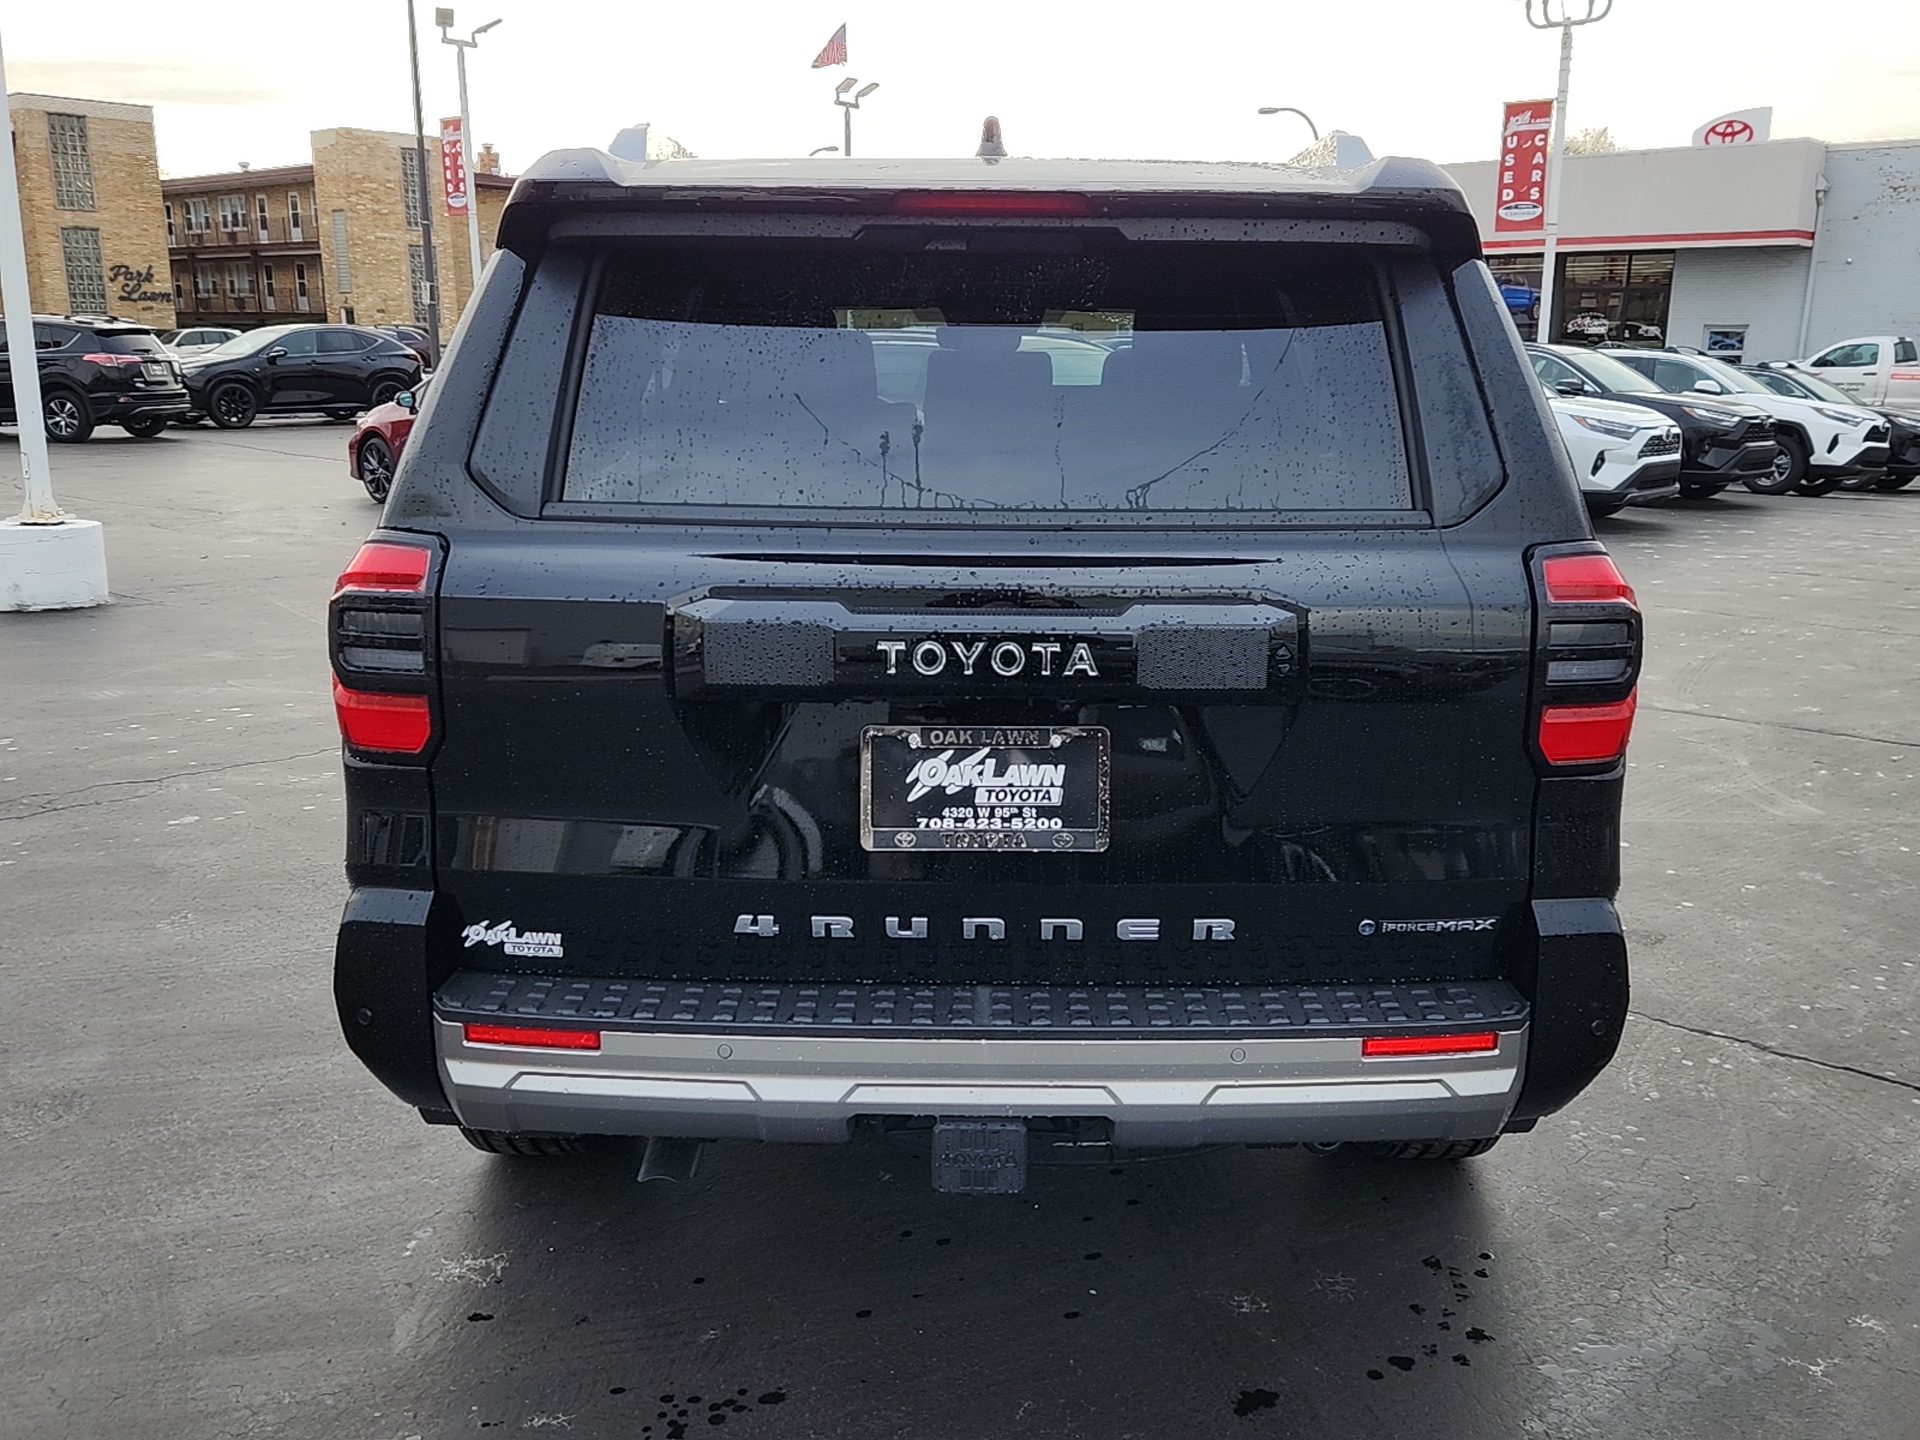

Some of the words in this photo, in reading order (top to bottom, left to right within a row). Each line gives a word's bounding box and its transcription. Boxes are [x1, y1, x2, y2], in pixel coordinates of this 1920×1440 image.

[444, 143, 454, 192] USED
[456, 142, 465, 192] CARS
[1502, 136, 1518, 201] USED
[1530, 134, 1546, 200] CARS
[109, 264, 154, 283] Park
[118, 283, 173, 303] Lawn
[876, 640, 1099, 676] TOYOTA
[930, 730, 972, 744] OAK
[980, 730, 1040, 745] LAWN
[984, 789, 1052, 803] TOYOTA
[941, 807, 973, 818] 4320
[976, 807, 991, 818] W
[994, 807, 1019, 818] 95th
[1022, 807, 1038, 818] St
[916, 818, 1063, 829] 708-423-5200
[940, 832, 1027, 848] TOYOTA
[733, 914, 1236, 941] 4RUNNER
[511, 945, 555, 954] TOYOTA
